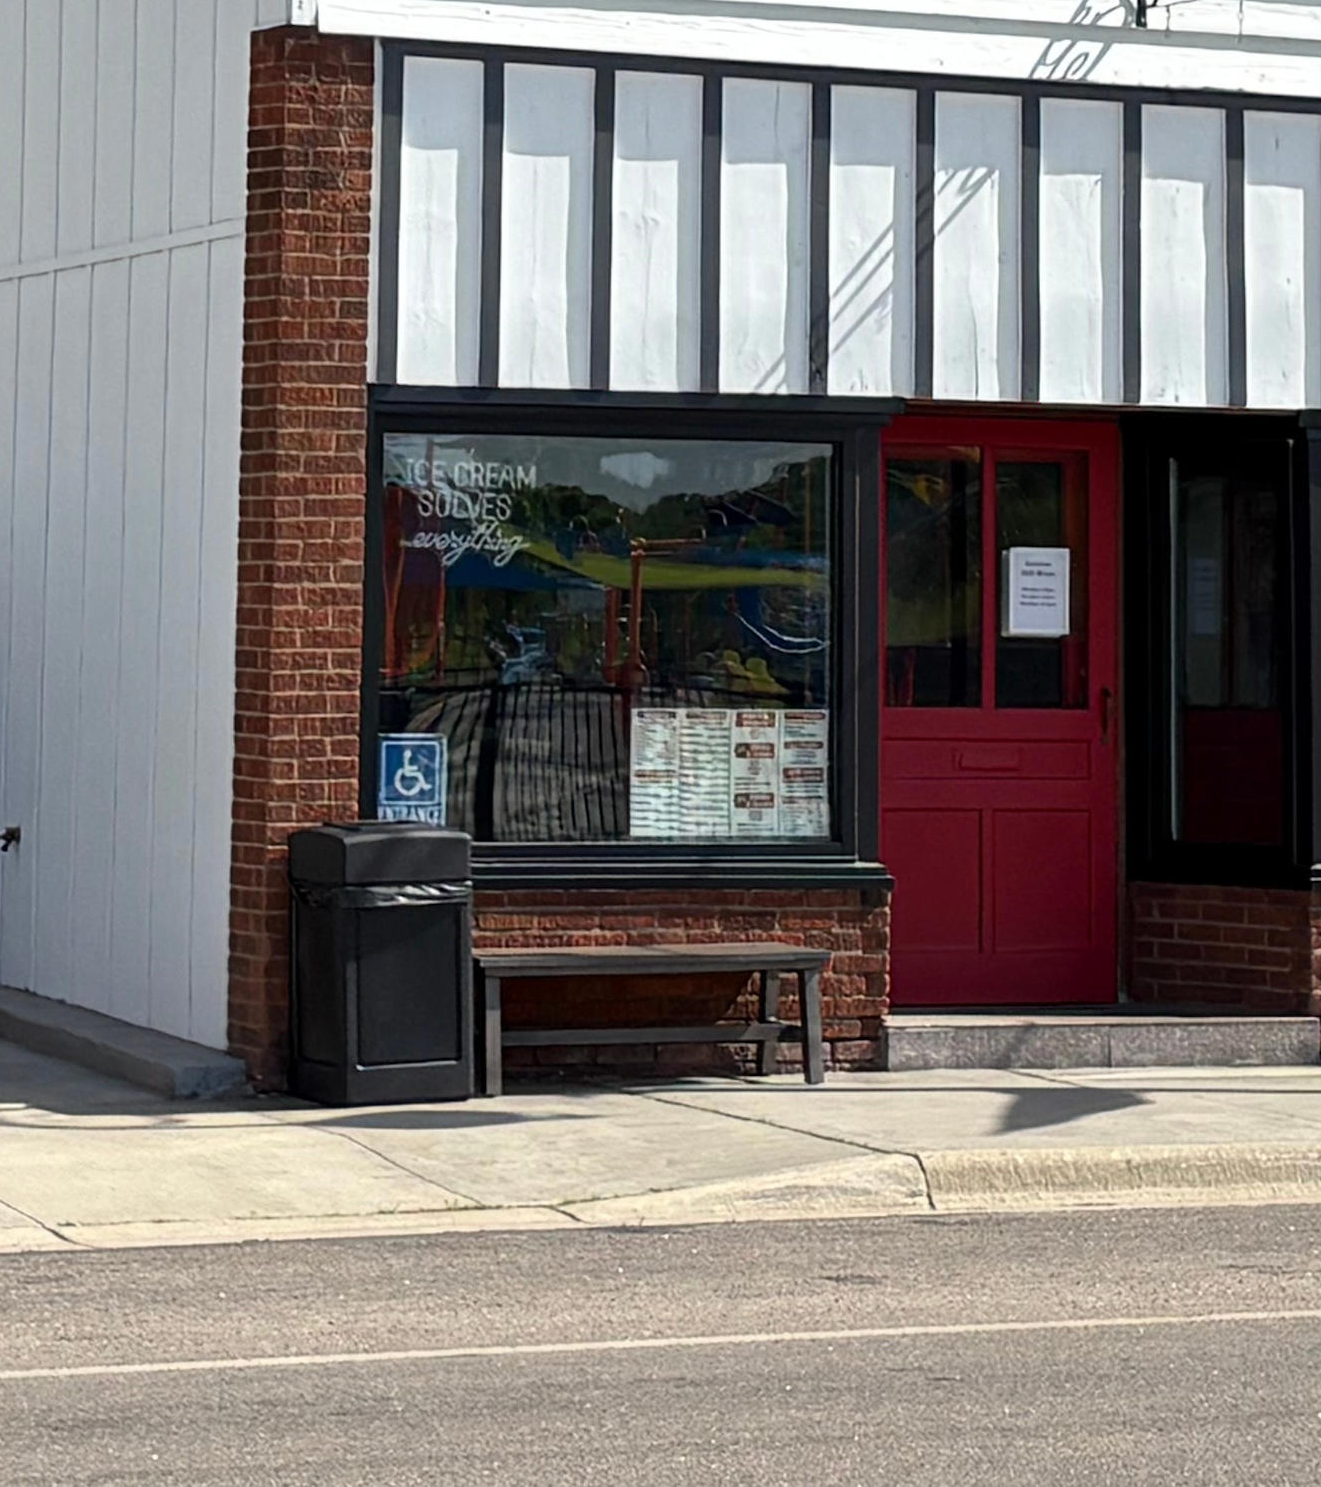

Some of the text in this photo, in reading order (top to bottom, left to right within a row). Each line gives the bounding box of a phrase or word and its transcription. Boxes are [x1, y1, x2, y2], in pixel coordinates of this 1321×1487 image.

[406, 459, 537, 490] ICE CREAM
[418, 490, 512, 521] SOLVES
[399, 516, 530, 566] everything
